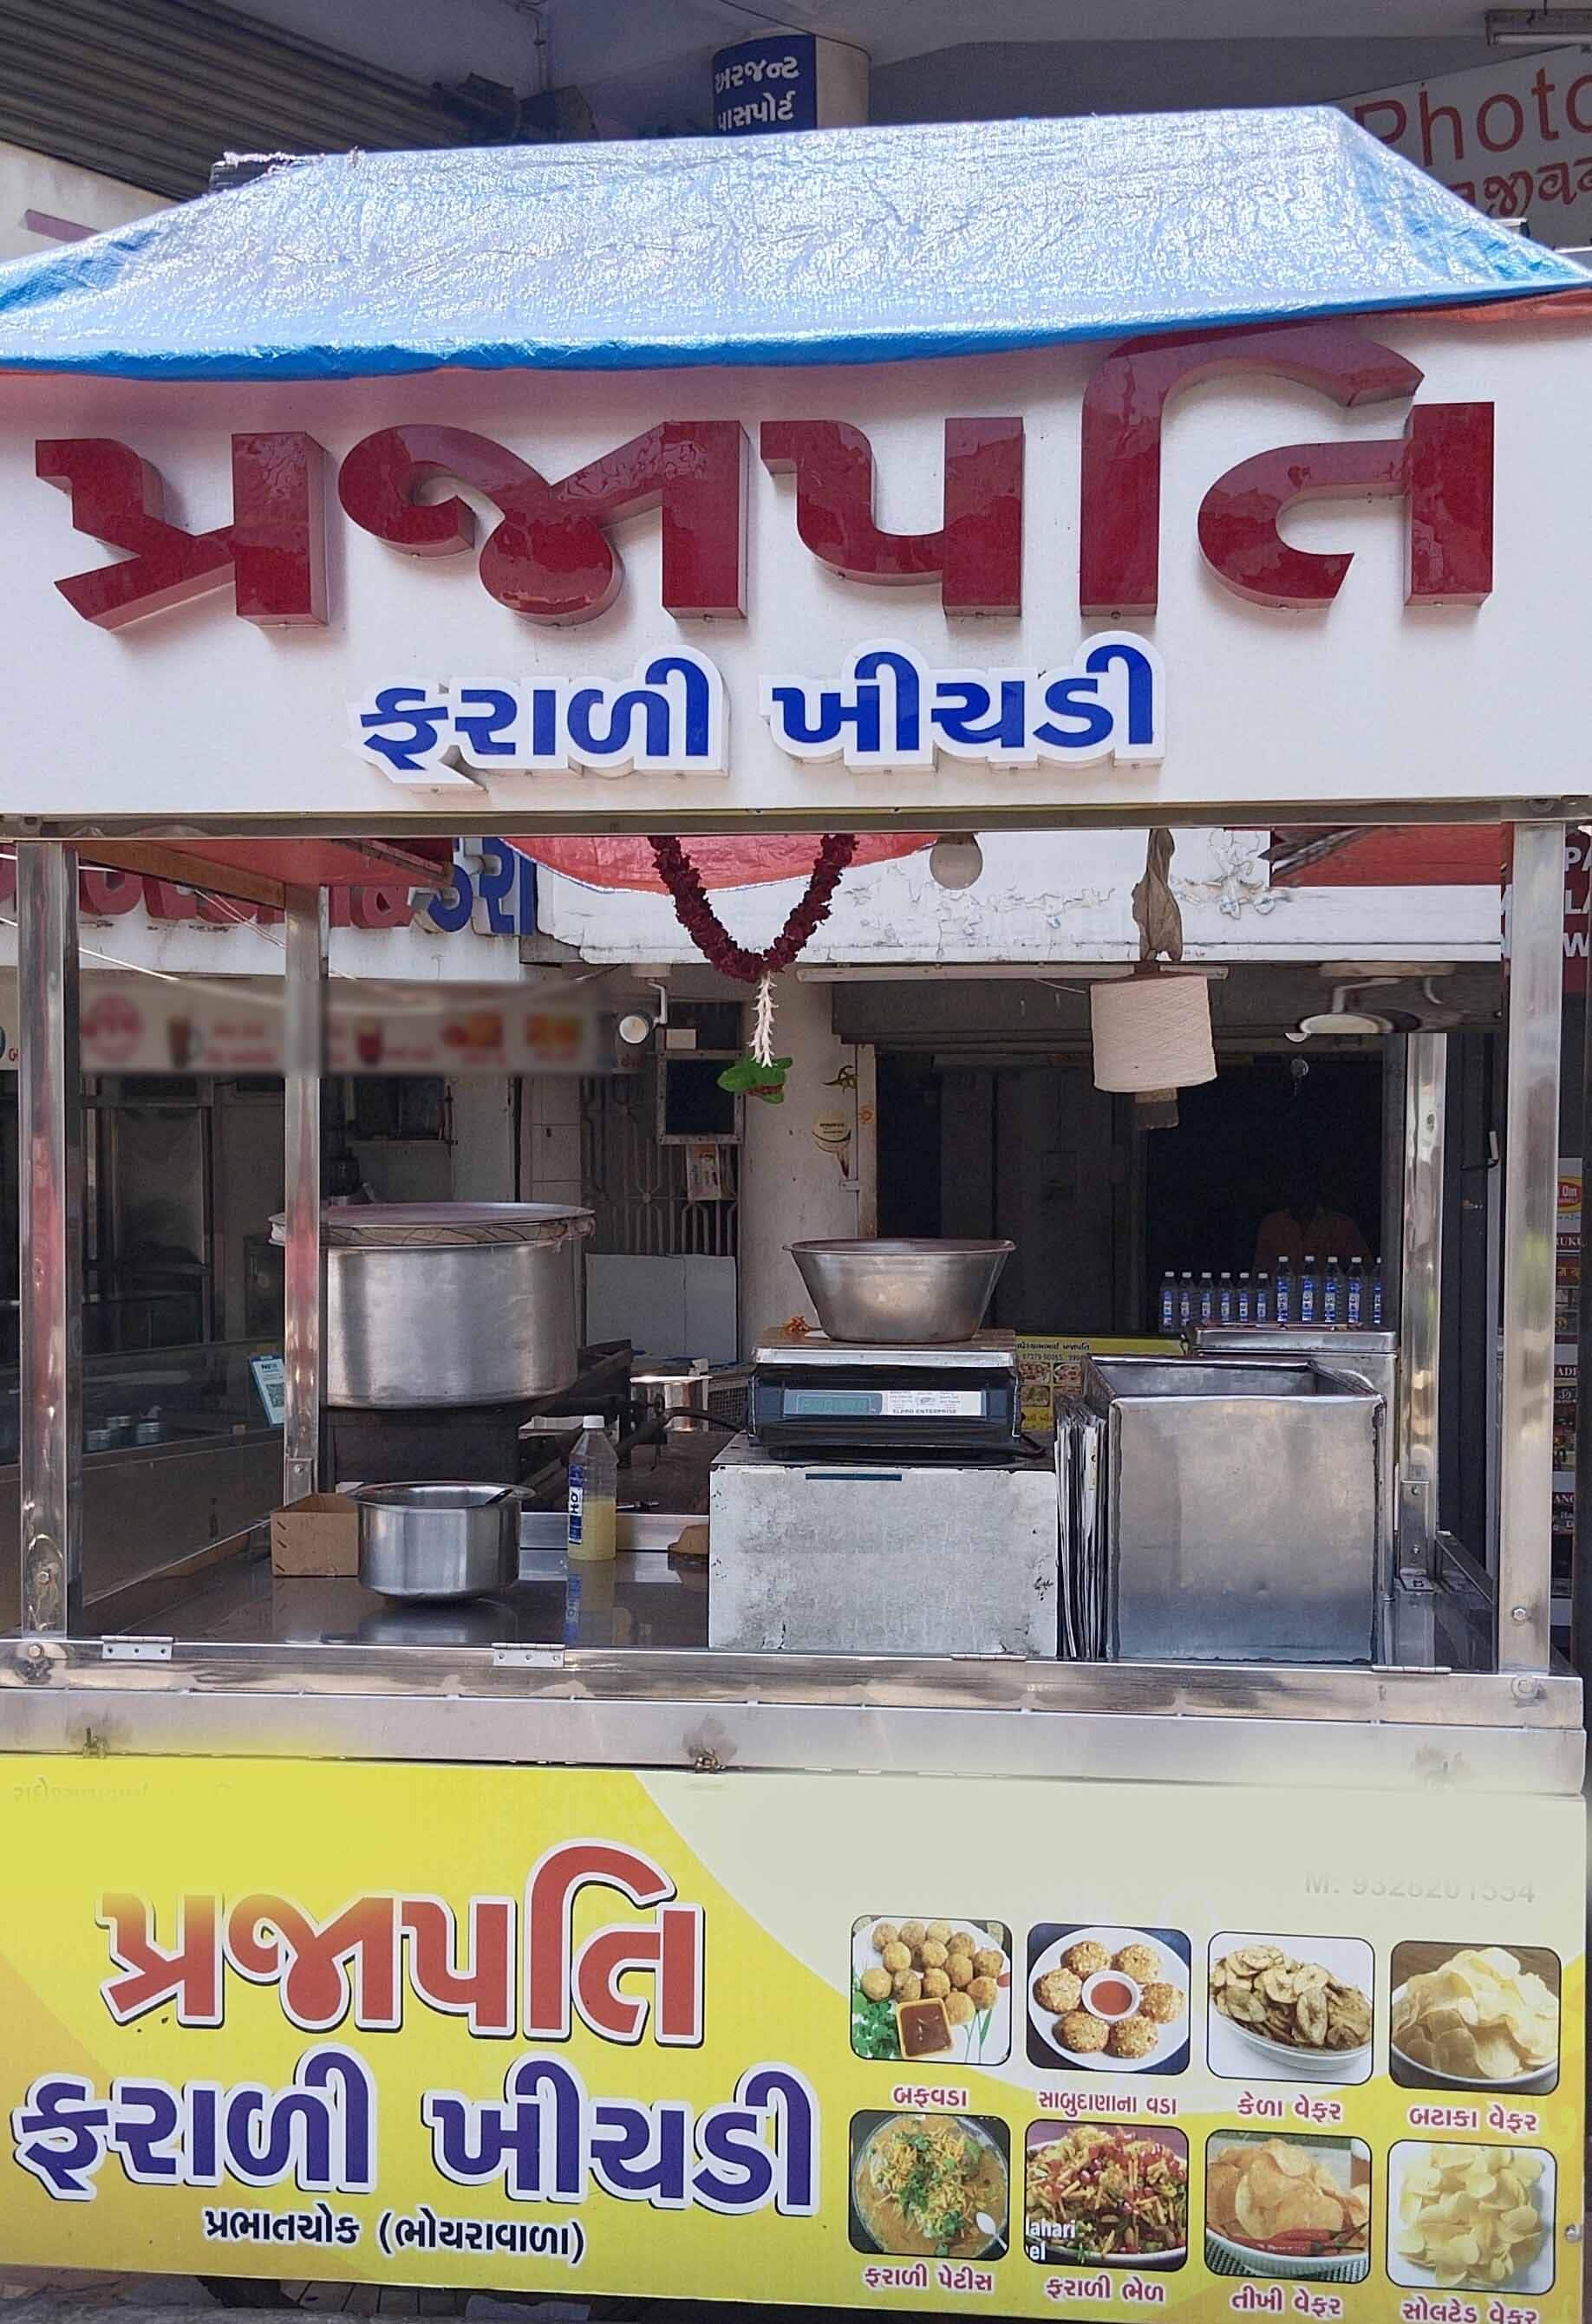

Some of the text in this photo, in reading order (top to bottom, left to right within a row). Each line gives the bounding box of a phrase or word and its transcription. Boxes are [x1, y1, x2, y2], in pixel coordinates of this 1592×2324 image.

[1352, 67, 1592, 168] Photo
[33, 321, 1497, 628] પ્રજાપતિ
[357, 642, 1157, 773] ફરાળી ખીચડી
[99, 1839, 706, 2049] પ્રજાપતિ
[893, 2086, 967, 2108] બફવડા
[1038, 2090, 1178, 2118] સાબુદાણાના વડા
[1237, 2090, 1341, 2123] કેળા વેફર
[16, 2047, 817, 2215] ફરાળી ખીચડી
[1409, 2104, 1537, 2134] બટાકા વેફર
[204, 2202, 585, 2265] પ્રભાતચોક (ભોયરાવાળા)
[865, 2262, 993, 2291] ફરાળી પેટીસ
[1046, 2274, 1165, 2302] ફરાળી ભેળ
[1231, 2285, 1341, 2317] તીખી વેફર
[1402, 2295, 1478, 2324] સોલટેડ
